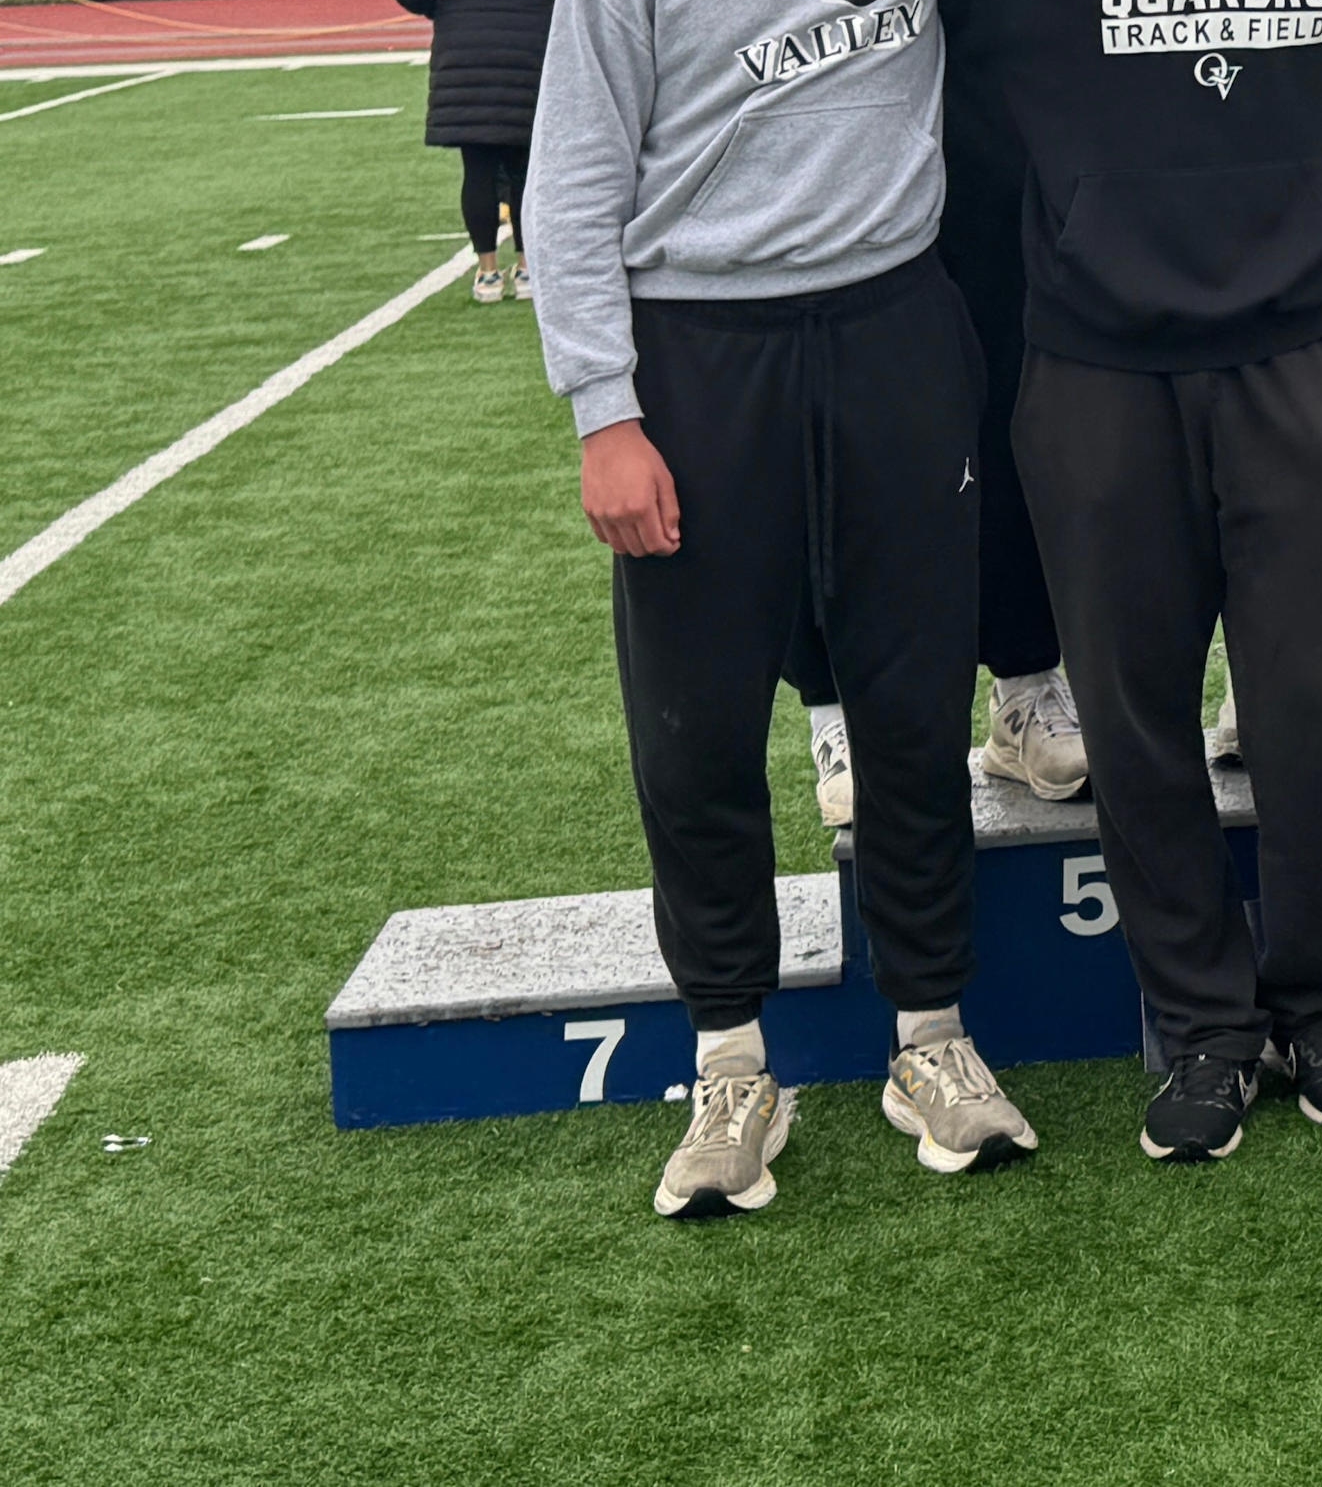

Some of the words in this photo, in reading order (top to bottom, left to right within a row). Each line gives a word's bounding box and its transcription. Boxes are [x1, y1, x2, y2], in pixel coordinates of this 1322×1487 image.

[1106, 18, 1211, 48] TRACK
[1219, 17, 1235, 42] &
[1193, 51, 1244, 101] QV
[1058, 854, 1121, 937] 5
[563, 1017, 626, 1103] 7
